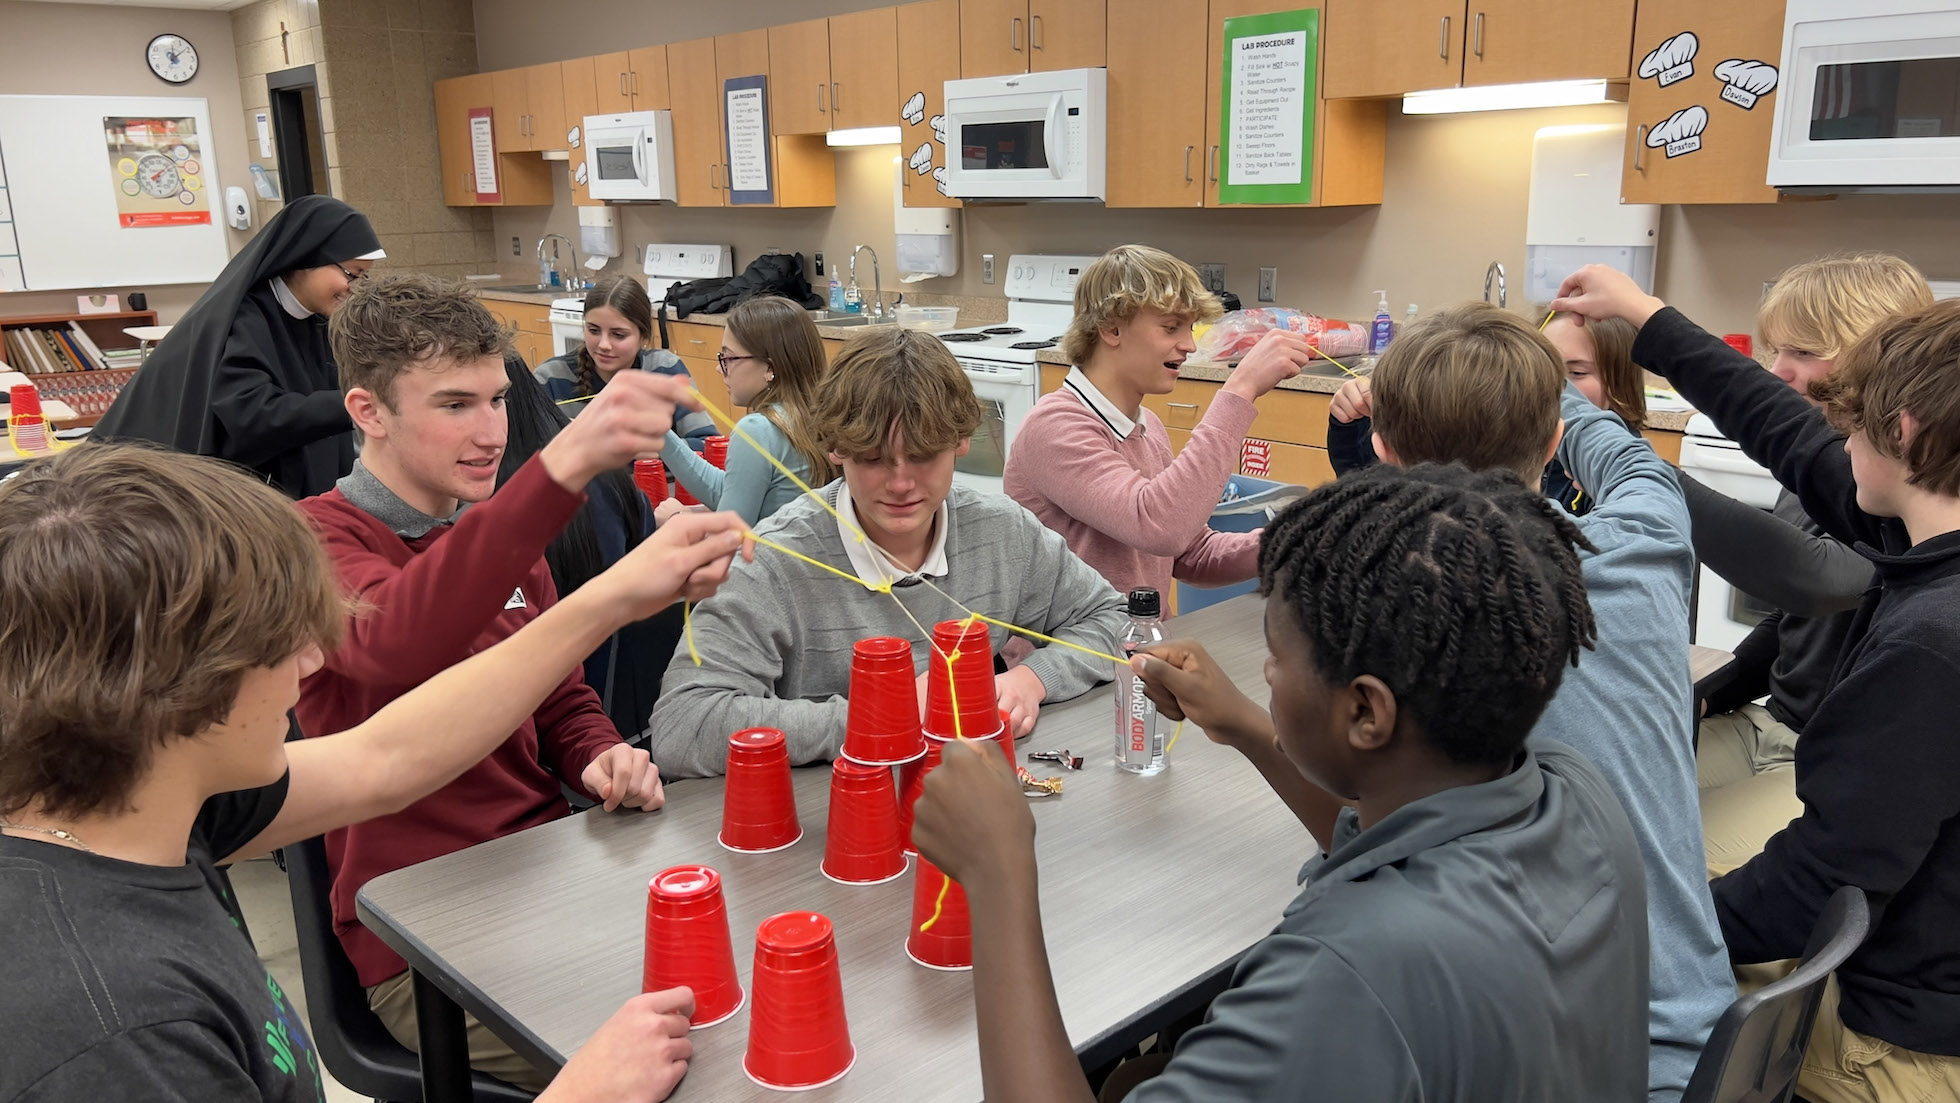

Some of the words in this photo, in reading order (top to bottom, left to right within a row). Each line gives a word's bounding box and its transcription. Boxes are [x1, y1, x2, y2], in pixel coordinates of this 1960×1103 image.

[1256, 38, 1295, 49] PROCEDURE
[1272, 61, 1283, 69] HOT
[1664, 69, 1682, 82] Evan
[1724, 87, 1750, 105] Dawson
[1669, 140, 1697, 154] Braxton
[1248, 445, 1265, 455] FIRE
